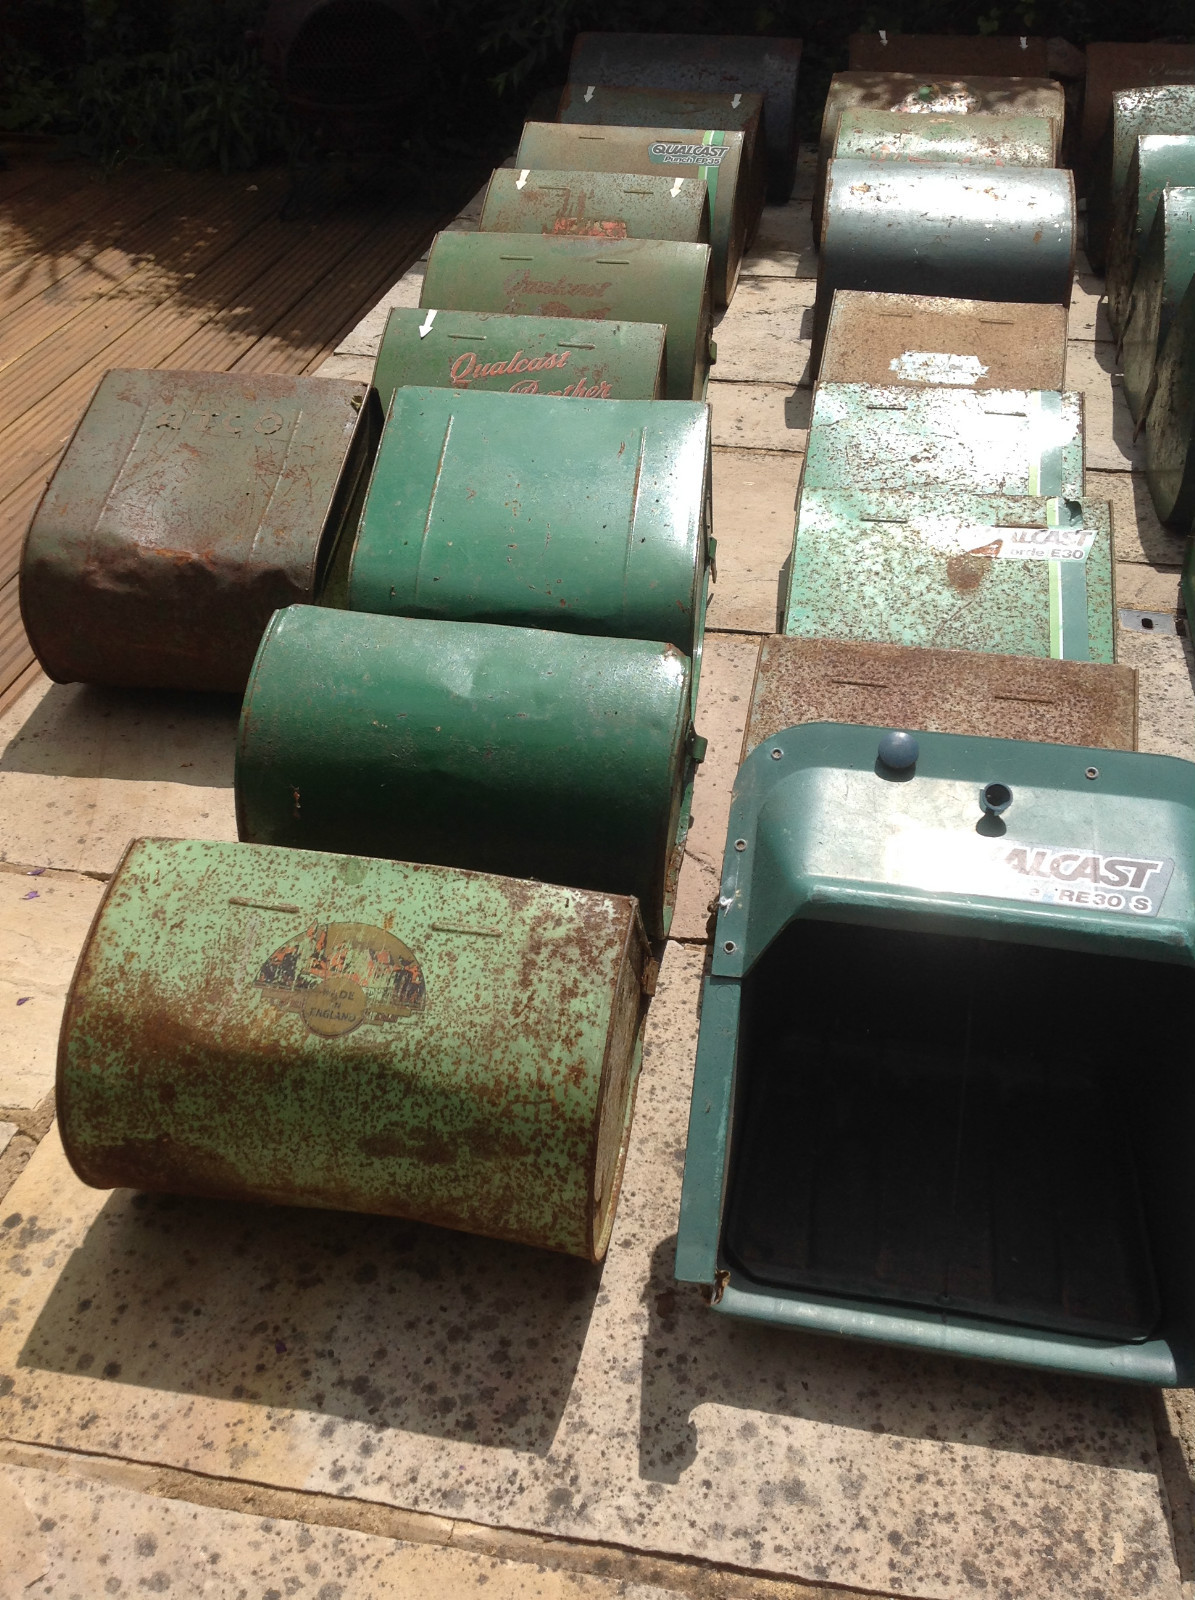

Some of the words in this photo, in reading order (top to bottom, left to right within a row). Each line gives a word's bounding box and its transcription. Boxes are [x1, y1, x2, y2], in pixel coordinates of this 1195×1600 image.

[652, 144, 729, 158] QUALCAST
[663, 156, 693, 164] Punch
[695, 157, 721, 165] EP35
[450, 350, 572, 384] Qualcast
[508, 377, 613, 399] Pther
[1050, 549, 1084, 559] E30
[1003, 847, 1162, 889] ALCAST
[1058, 889, 1123, 908] RE30
[1133, 897, 1150, 911] S
[310, 1007, 357, 1022] ENGLAND
